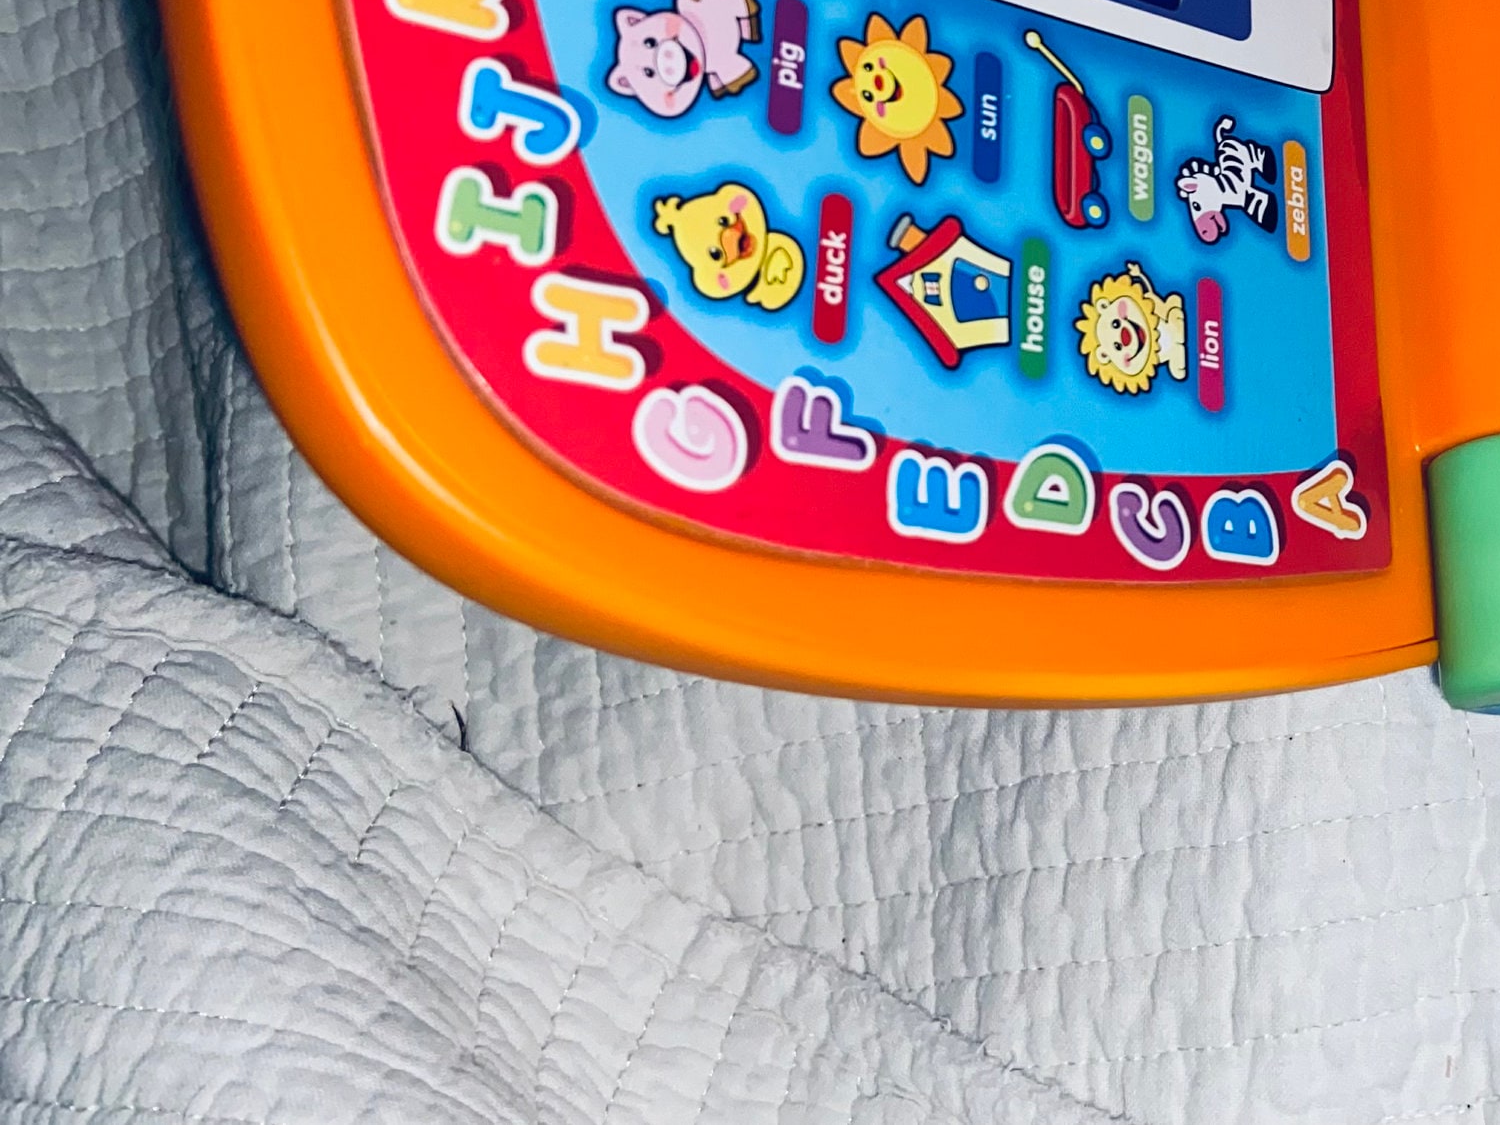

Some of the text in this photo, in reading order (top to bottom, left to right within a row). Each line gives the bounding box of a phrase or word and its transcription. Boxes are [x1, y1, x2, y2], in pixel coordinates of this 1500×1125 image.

[772, 41, 805, 89] pig
[458, 58, 581, 165] J
[981, 93, 998, 140] sun
[1133, 113, 1154, 201] wagon
[1285, 166, 1306, 235] zebra
[435, 167, 558, 266] I
[817, 230, 846, 305] duck
[1020, 265, 1045, 353] house
[522, 272, 649, 391] H
[1200, 320, 1220, 370] lion
[632, 385, 748, 493] G
[770, 377, 876, 470] F
[887, 449, 988, 543] E
[1004, 444, 1095, 535] D
[1109, 483, 1190, 570] C
[1202, 489, 1279, 565] B
[1292, 460, 1367, 540] A
